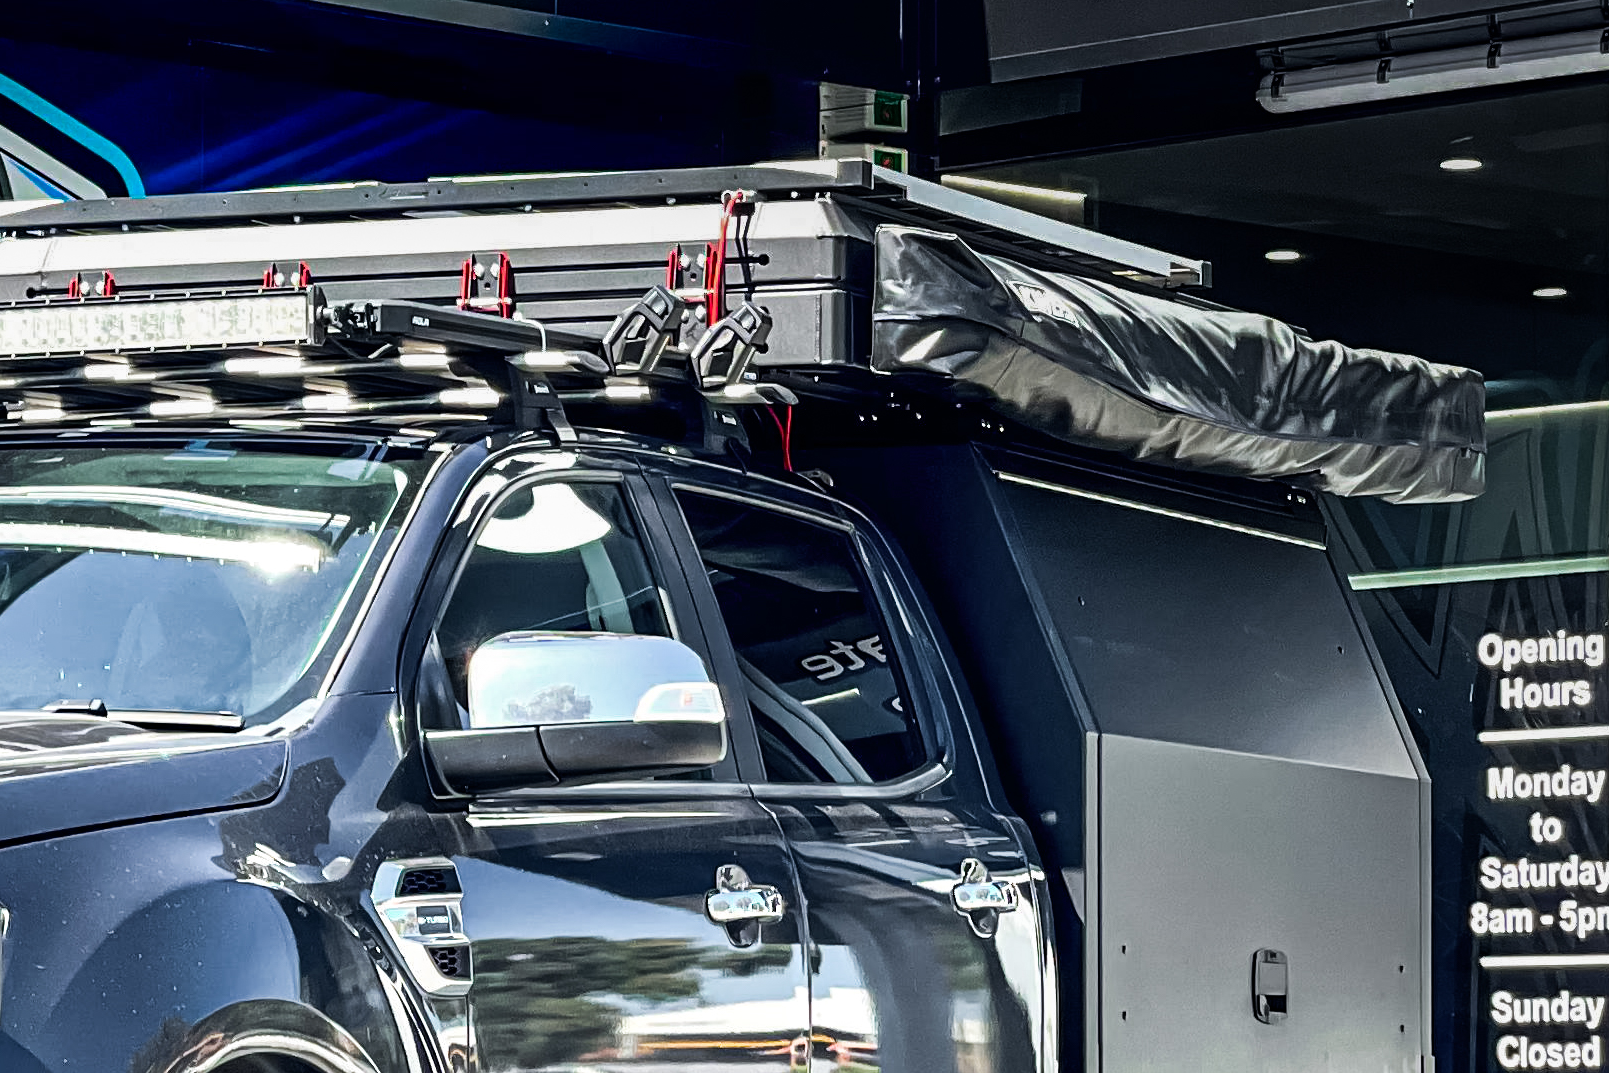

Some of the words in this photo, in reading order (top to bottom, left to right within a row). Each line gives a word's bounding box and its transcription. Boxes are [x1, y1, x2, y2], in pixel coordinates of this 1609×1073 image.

[1478, 629, 1604, 672] Opening
[1500, 677, 1591, 709] Hours
[1487, 764, 1606, 802] Monday
[1530, 811, 1562, 843] to
[1480, 854, 1609, 894] Saturday
[1471, 901, 1533, 934] 8am
[1491, 989, 1605, 1030] Sunday
[1496, 1034, 1601, 1068] Closed
